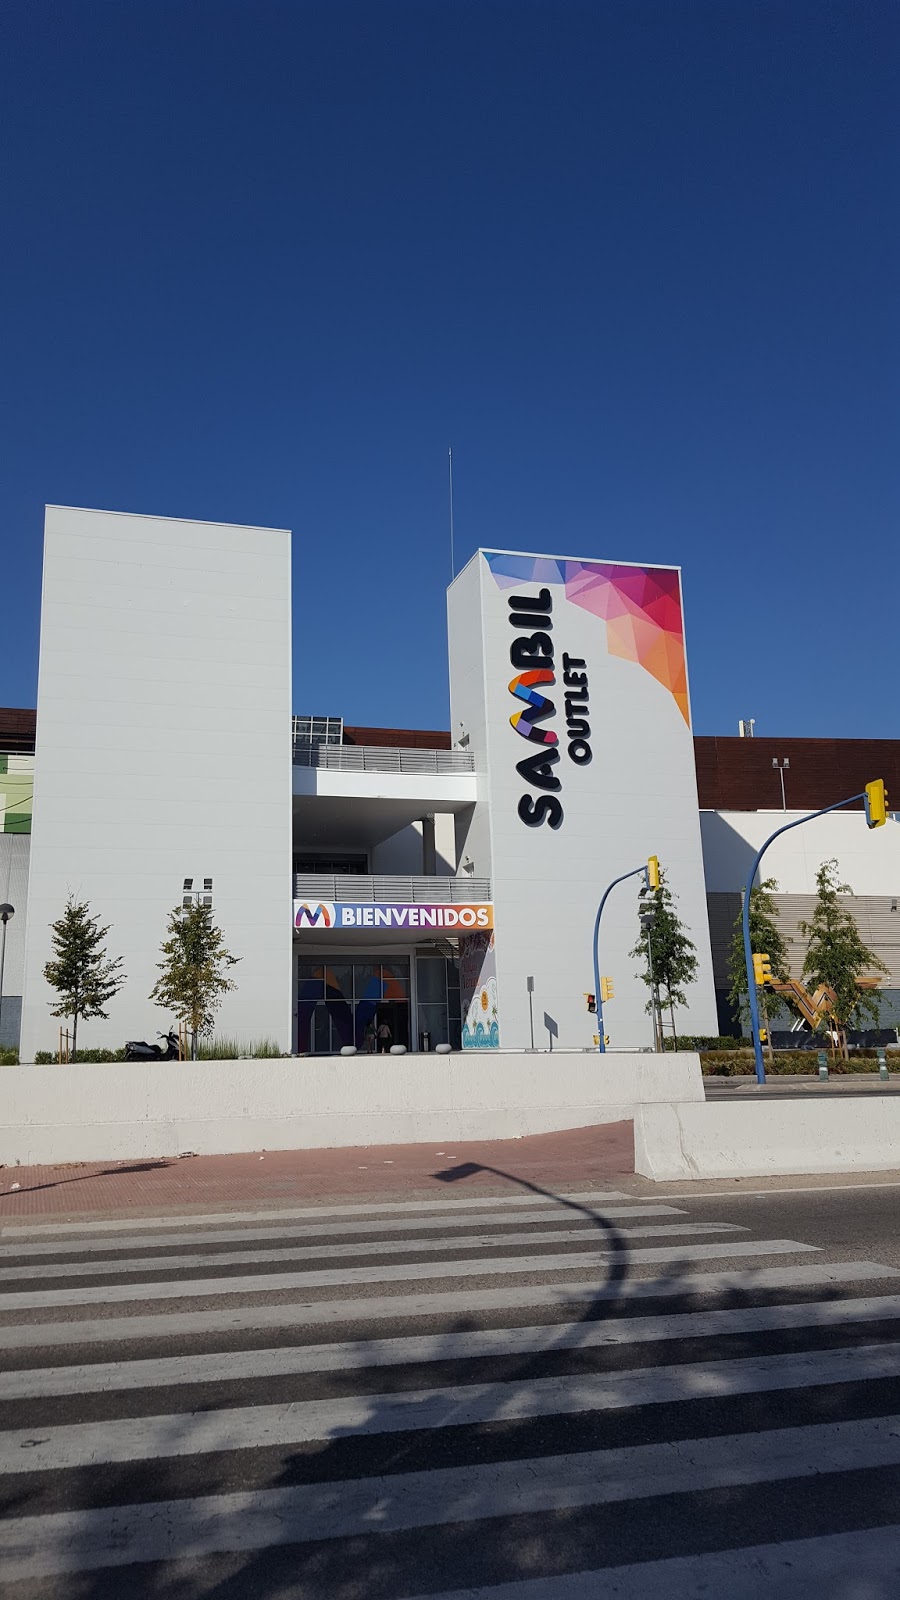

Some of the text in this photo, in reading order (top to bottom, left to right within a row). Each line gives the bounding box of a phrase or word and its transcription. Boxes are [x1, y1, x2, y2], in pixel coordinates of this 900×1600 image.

[508, 588, 563, 829] SAMBIL
[563, 652, 592, 765] OUTLET
[341, 907, 489, 926] BIENVENIDOS
